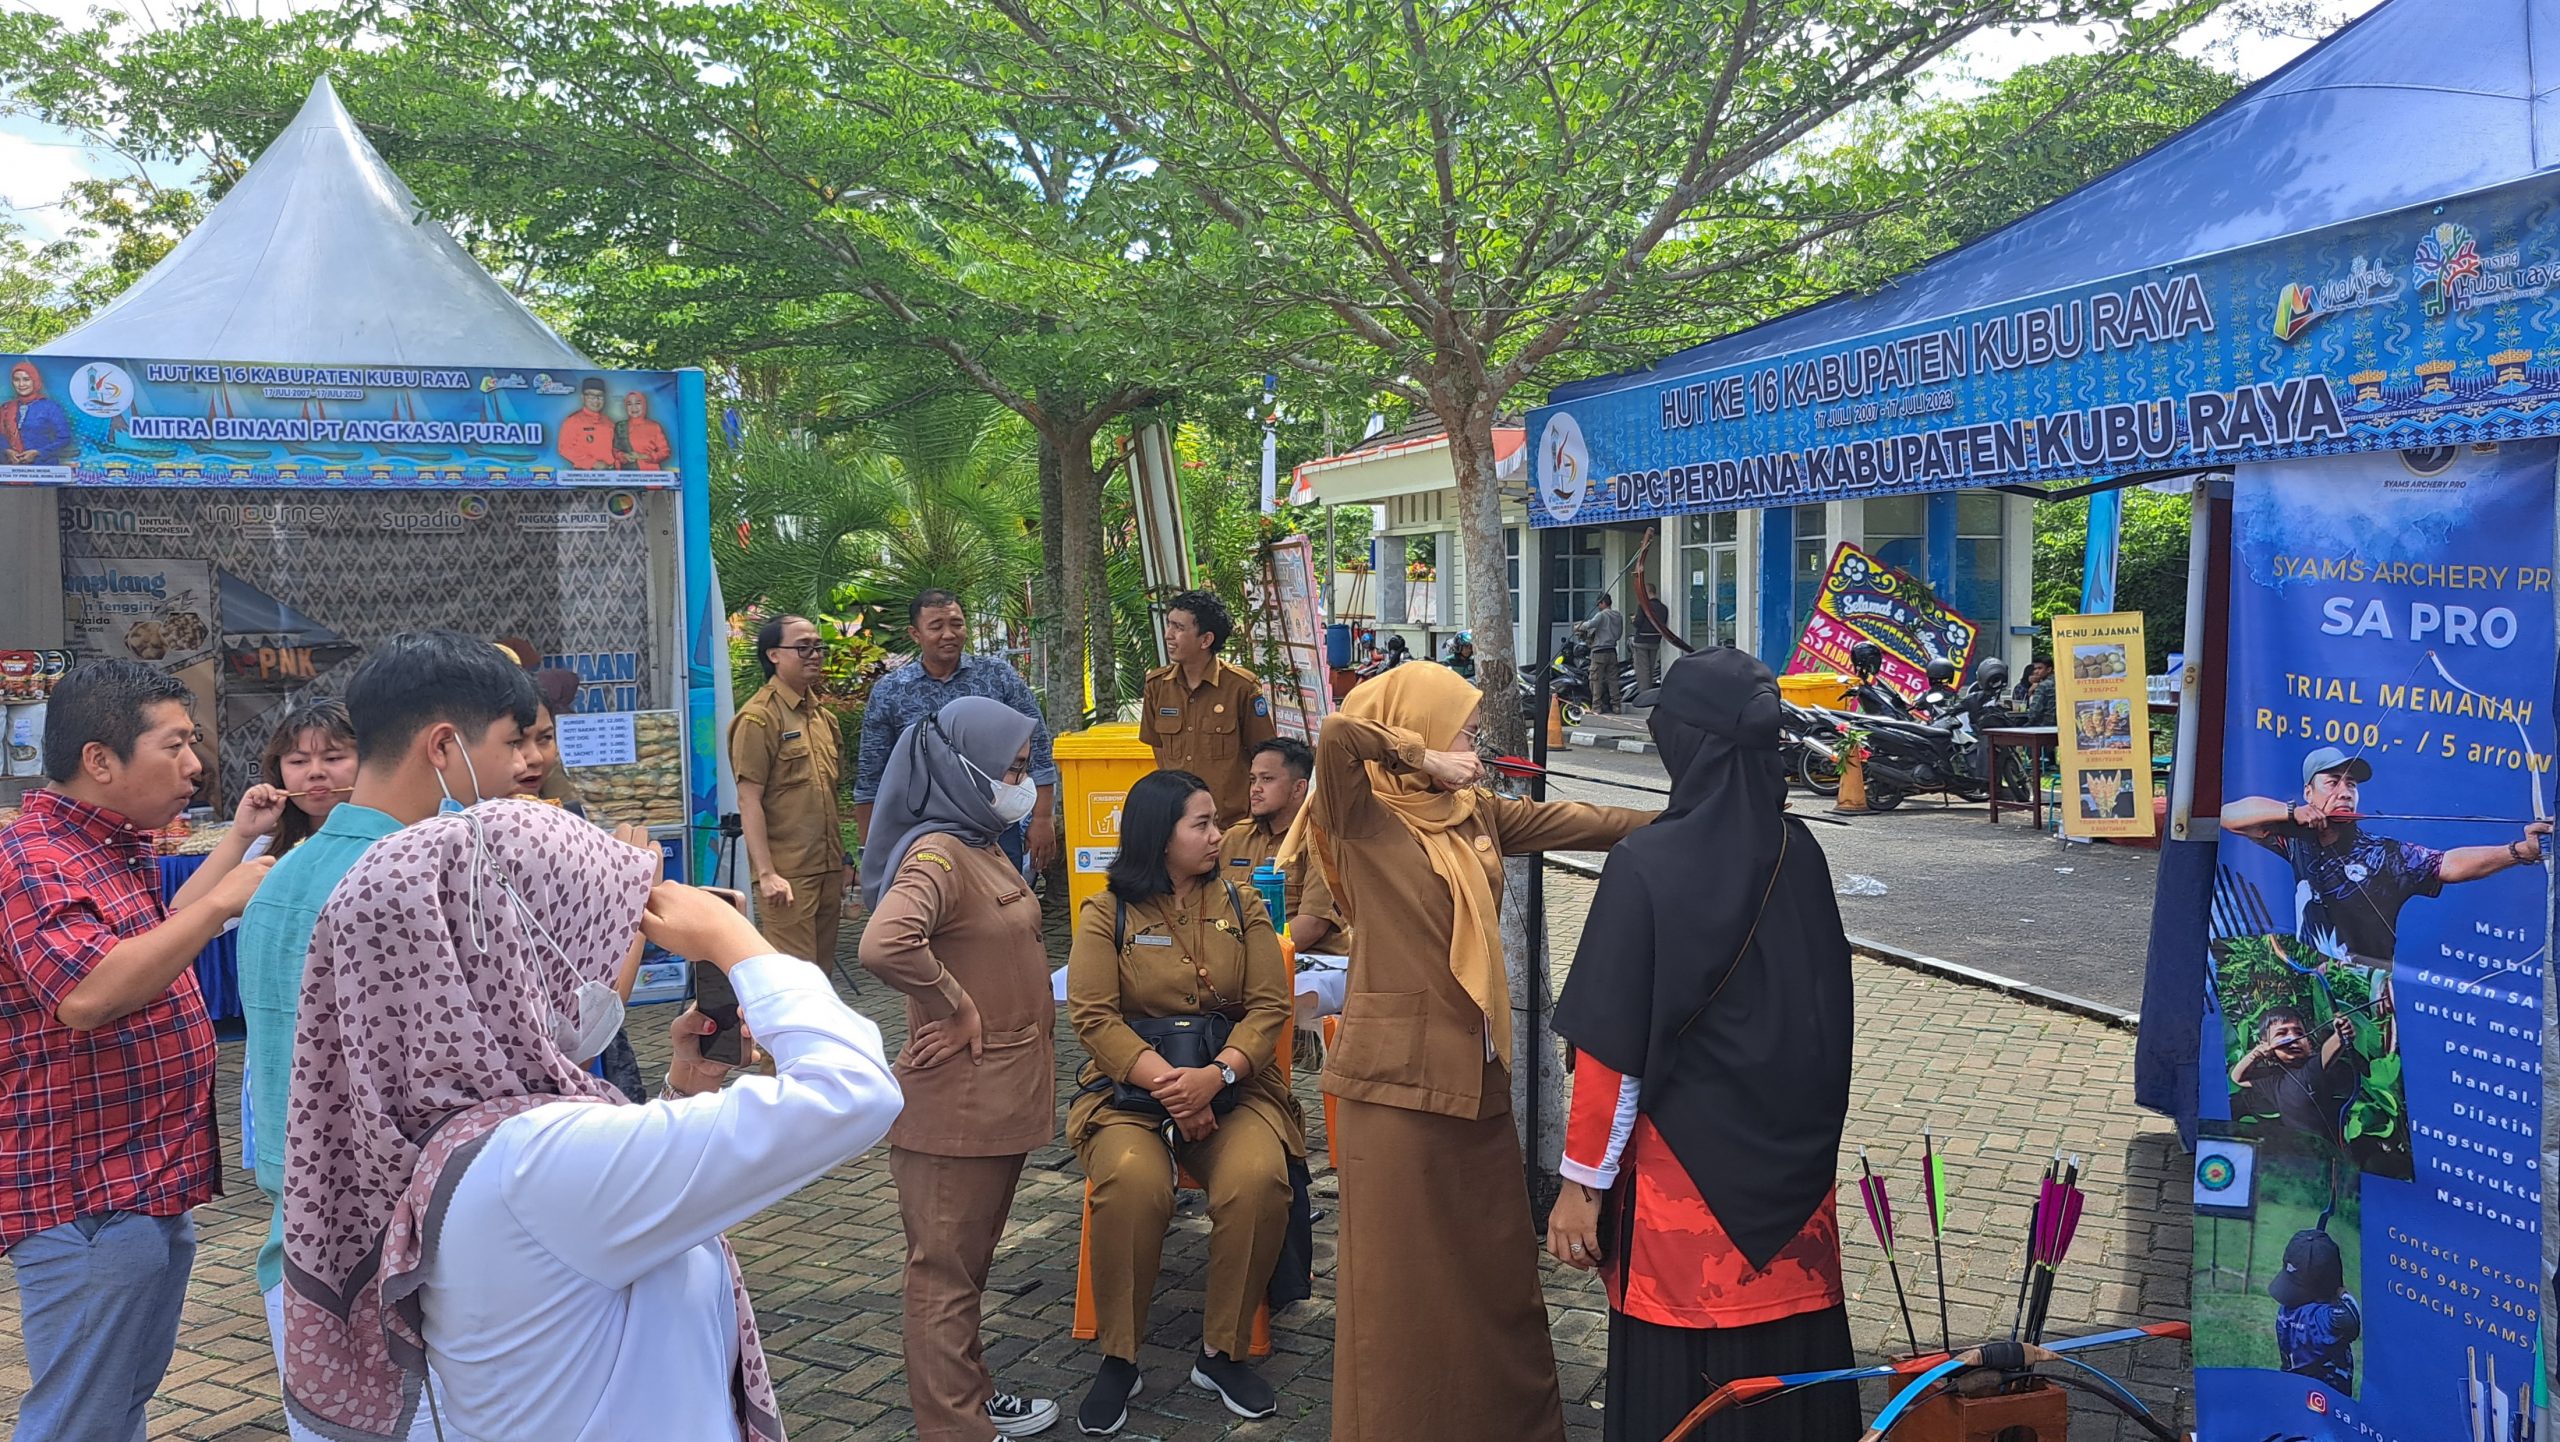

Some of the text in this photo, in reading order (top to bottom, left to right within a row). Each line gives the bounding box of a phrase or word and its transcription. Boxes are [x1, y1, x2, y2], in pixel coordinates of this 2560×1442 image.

[1661, 274, 2213, 430] HUT KE 16 KABUPATEN KUBU RAYA
[148, 365, 190, 382] HUT
[194, 366, 219, 382] KE
[224, 367, 246, 382] 16
[251, 368, 363, 386] KABUPATEN
[366, 371, 419, 388] KUBU
[421, 372, 470, 389] RAYA
[264, 388, 274, 398] 17
[291, 388, 310, 398] 2007
[317, 389, 328, 399] 17
[344, 390, 363, 400] 2023
[1814, 411, 1826, 428] 17
[1827, 408, 1850, 427] JULI
[1854, 402, 1878, 422] 2007
[1886, 399, 1898, 418] 17
[1900, 394, 1925, 416] JULI
[1926, 390, 1953, 411] 2023
[131, 417, 543, 444] MITRA BINAAN PT ANGKASA PURA II
[1616, 375, 2346, 510] DPC PERDANA KABUPATEN KUBU RAYA
[2384, 480, 2467, 489] SYAMS ARCHERY PRO
[139, 518, 172, 527] UNTUK
[139, 526, 191, 534] INDONESIA
[208, 505, 341, 528] injourney
[383, 510, 462, 532] Supadio
[517, 514, 568, 524] ANGKASA
[571, 514, 598, 524] PURA
[2273, 555, 2365, 582] SYAMS
[2372, 561, 2509, 590] ARCHERY
[1843, 594, 1892, 617] Selamat
[1894, 608, 1904, 623] &
[2320, 597, 2517, 649] SA PRO
[2057, 626, 2140, 639] MENU JAJANAN
[258, 647, 318, 681] PNK
[2286, 673, 2533, 725] TRIAL MEMANAH
[2300, 716, 2402, 752] 5.000,-
[2416, 731, 2430, 753] /
[2442, 734, 2455, 757] 5
[2468, 742, 2552, 773] arrow
[2475, 921, 2525, 942] Mari
[2418, 970, 2533, 1009] dengan SA
[2415, 1001, 2476, 1026] untuk
[2452, 1071, 2537, 1106] handal.
[2453, 1103, 2532, 1137] Dilatih
[2413, 1120, 2513, 1165] langsung
[2388, 1227, 2539, 1294] Contact Person
[2389, 1254, 2536, 1322] 0896 9487 3408
[2387, 1279, 2536, 1353] (COACH SYAMS)
